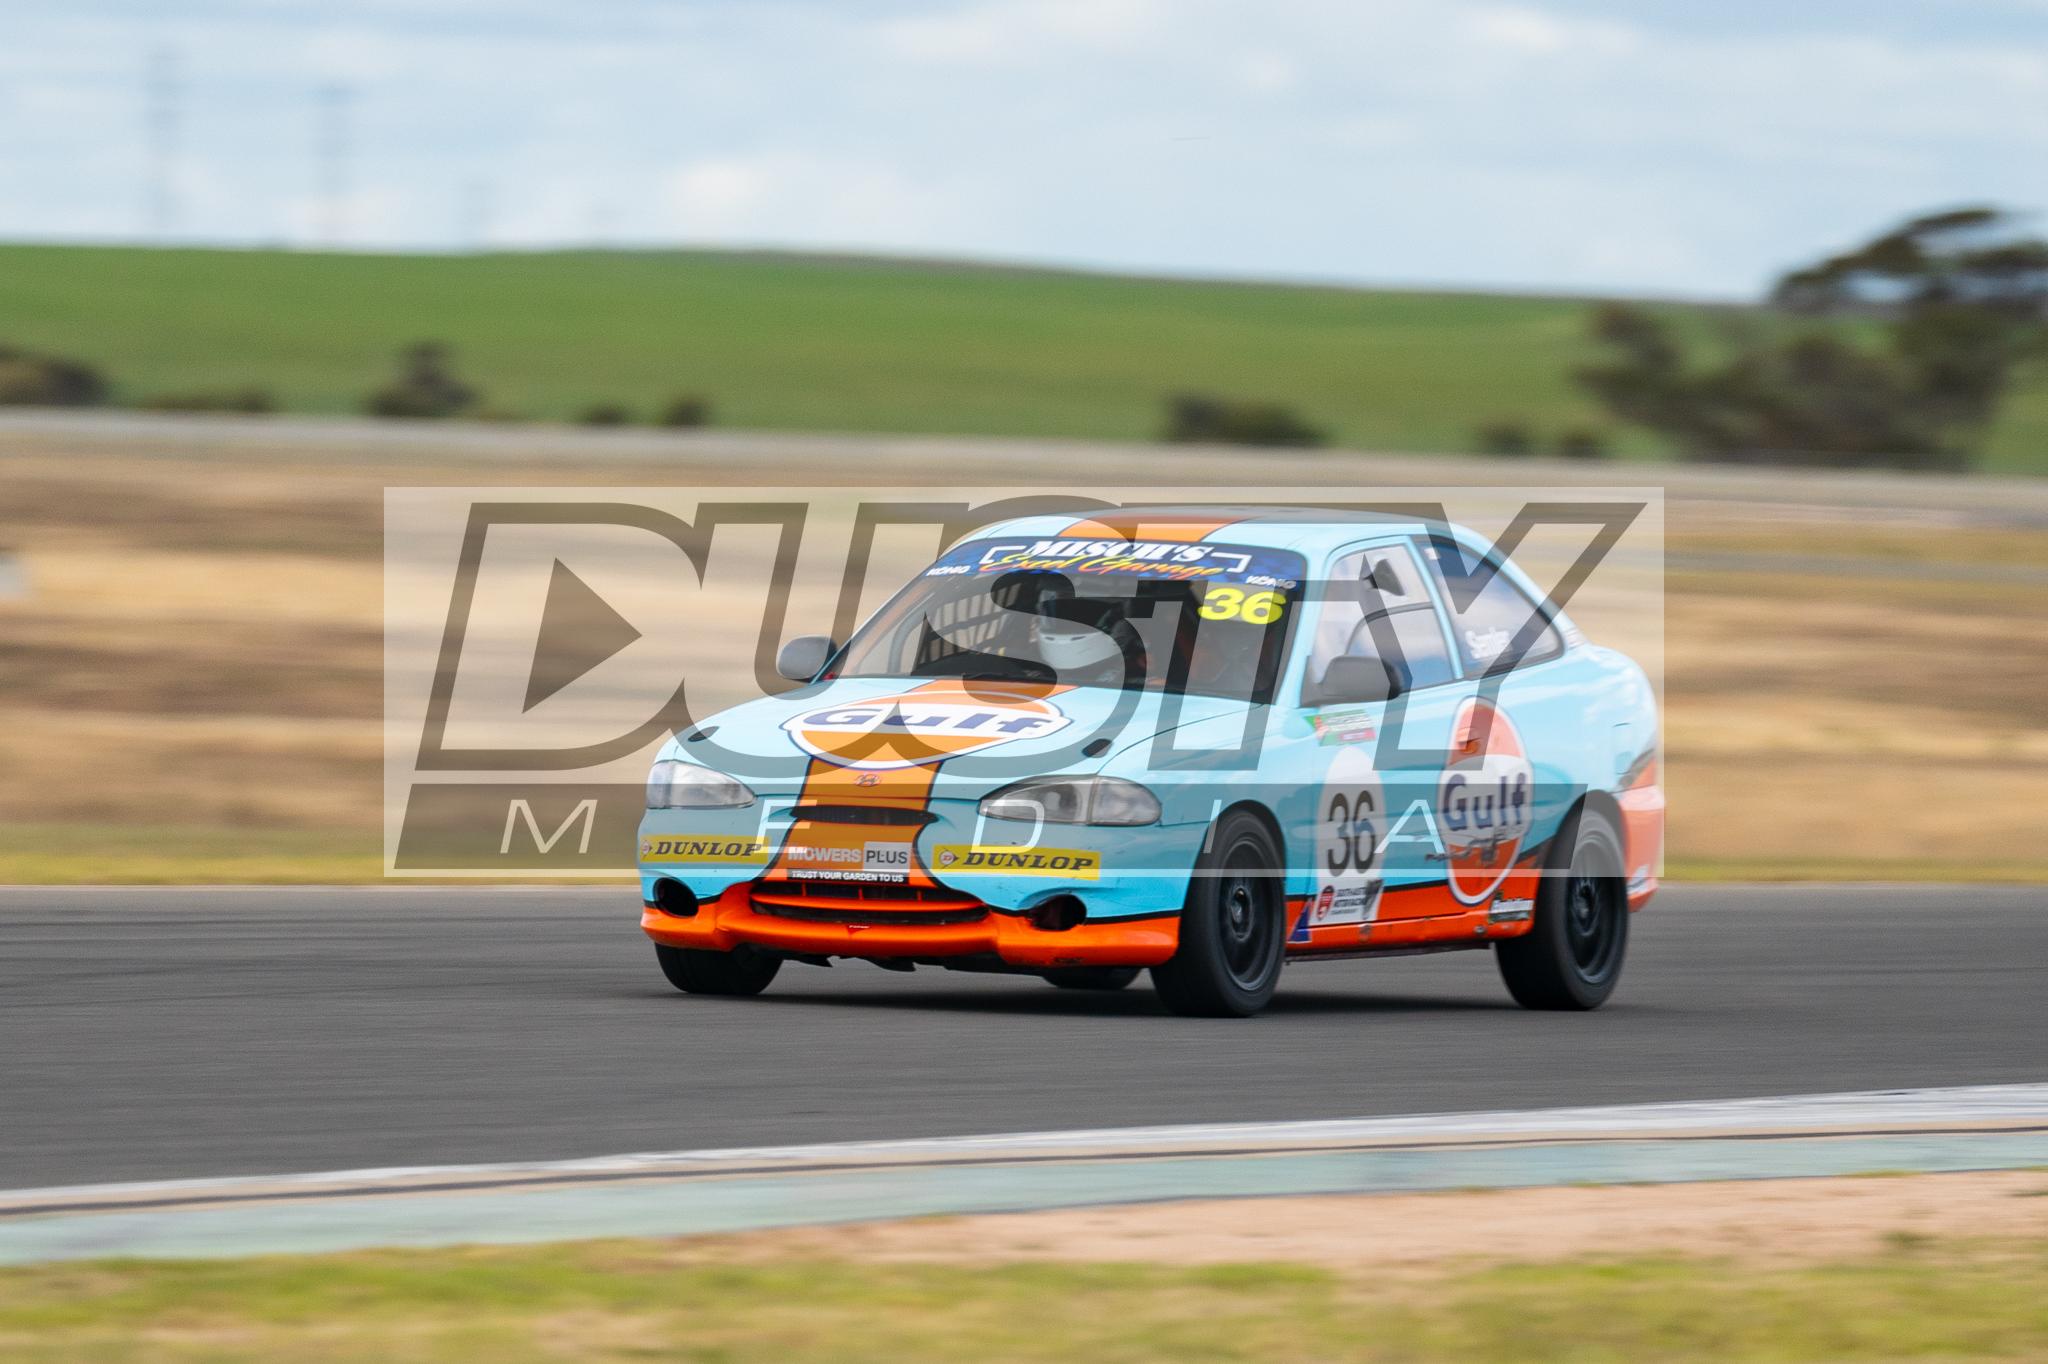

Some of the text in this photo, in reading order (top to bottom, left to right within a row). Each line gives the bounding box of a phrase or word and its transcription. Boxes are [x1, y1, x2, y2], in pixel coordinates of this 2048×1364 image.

[979, 554, 1225, 580] Excel Garage
[1197, 587, 1287, 625] 36
[803, 708, 1052, 733] Gulf
[1442, 772, 1527, 831] Gulf
[1327, 789, 1376, 877] 36
[654, 841, 763, 856] DUNLOP
[787, 847, 909, 864] MOWERS PLUS
[963, 852, 1093, 870] DUNLOP
[792, 870, 818, 879] TRUST
[819, 871, 841, 880] YOUR
[842, 872, 878, 882] GARDEN
[878, 873, 892, 882] TO
